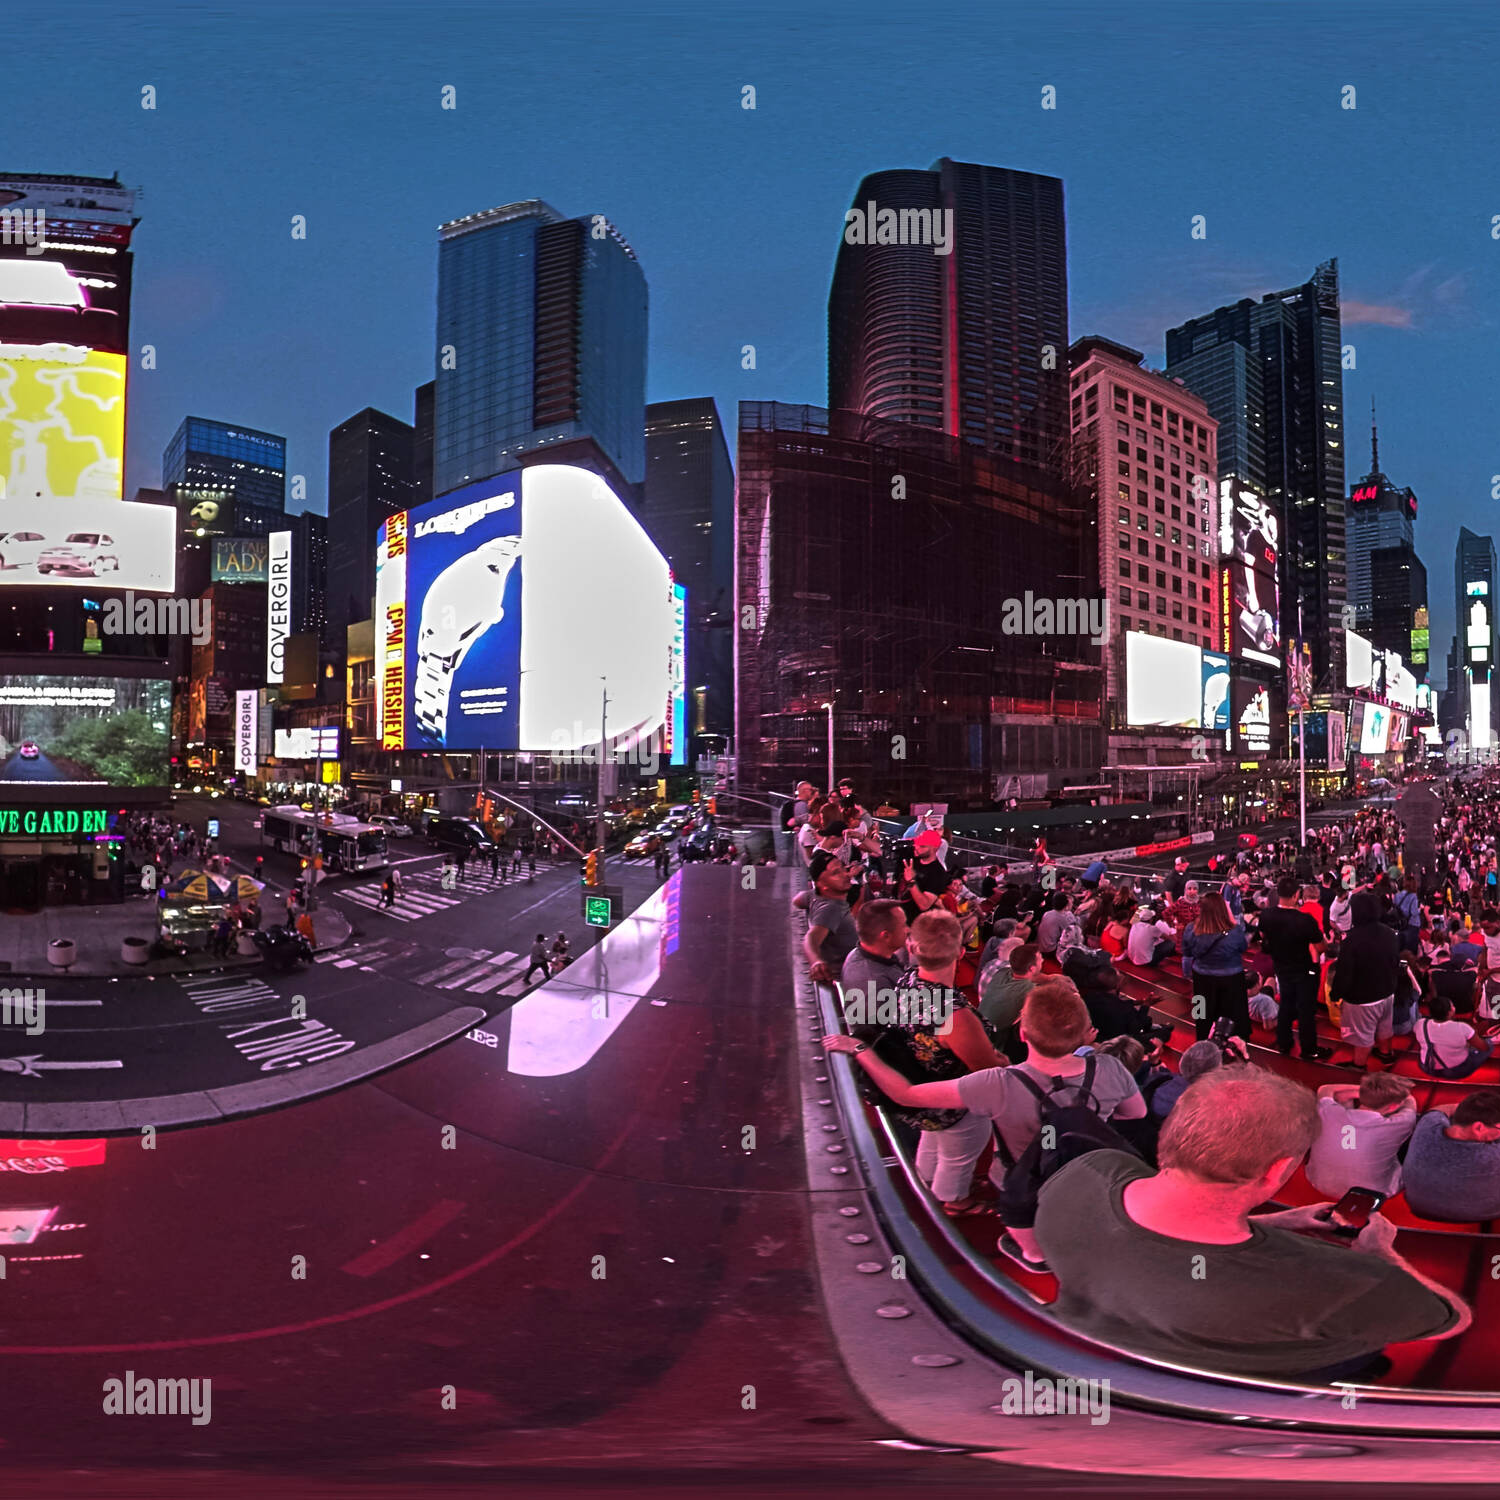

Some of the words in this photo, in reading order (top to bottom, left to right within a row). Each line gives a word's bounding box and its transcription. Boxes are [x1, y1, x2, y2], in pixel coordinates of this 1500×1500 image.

[216, 552, 268, 572] LADY
[270, 549, 288, 675] COVERGIRL
[241, 694, 252, 766] COVERGIRL
[384, 667, 403, 750] HERSHEY'S
[24, 809, 107, 833] GARDEN
